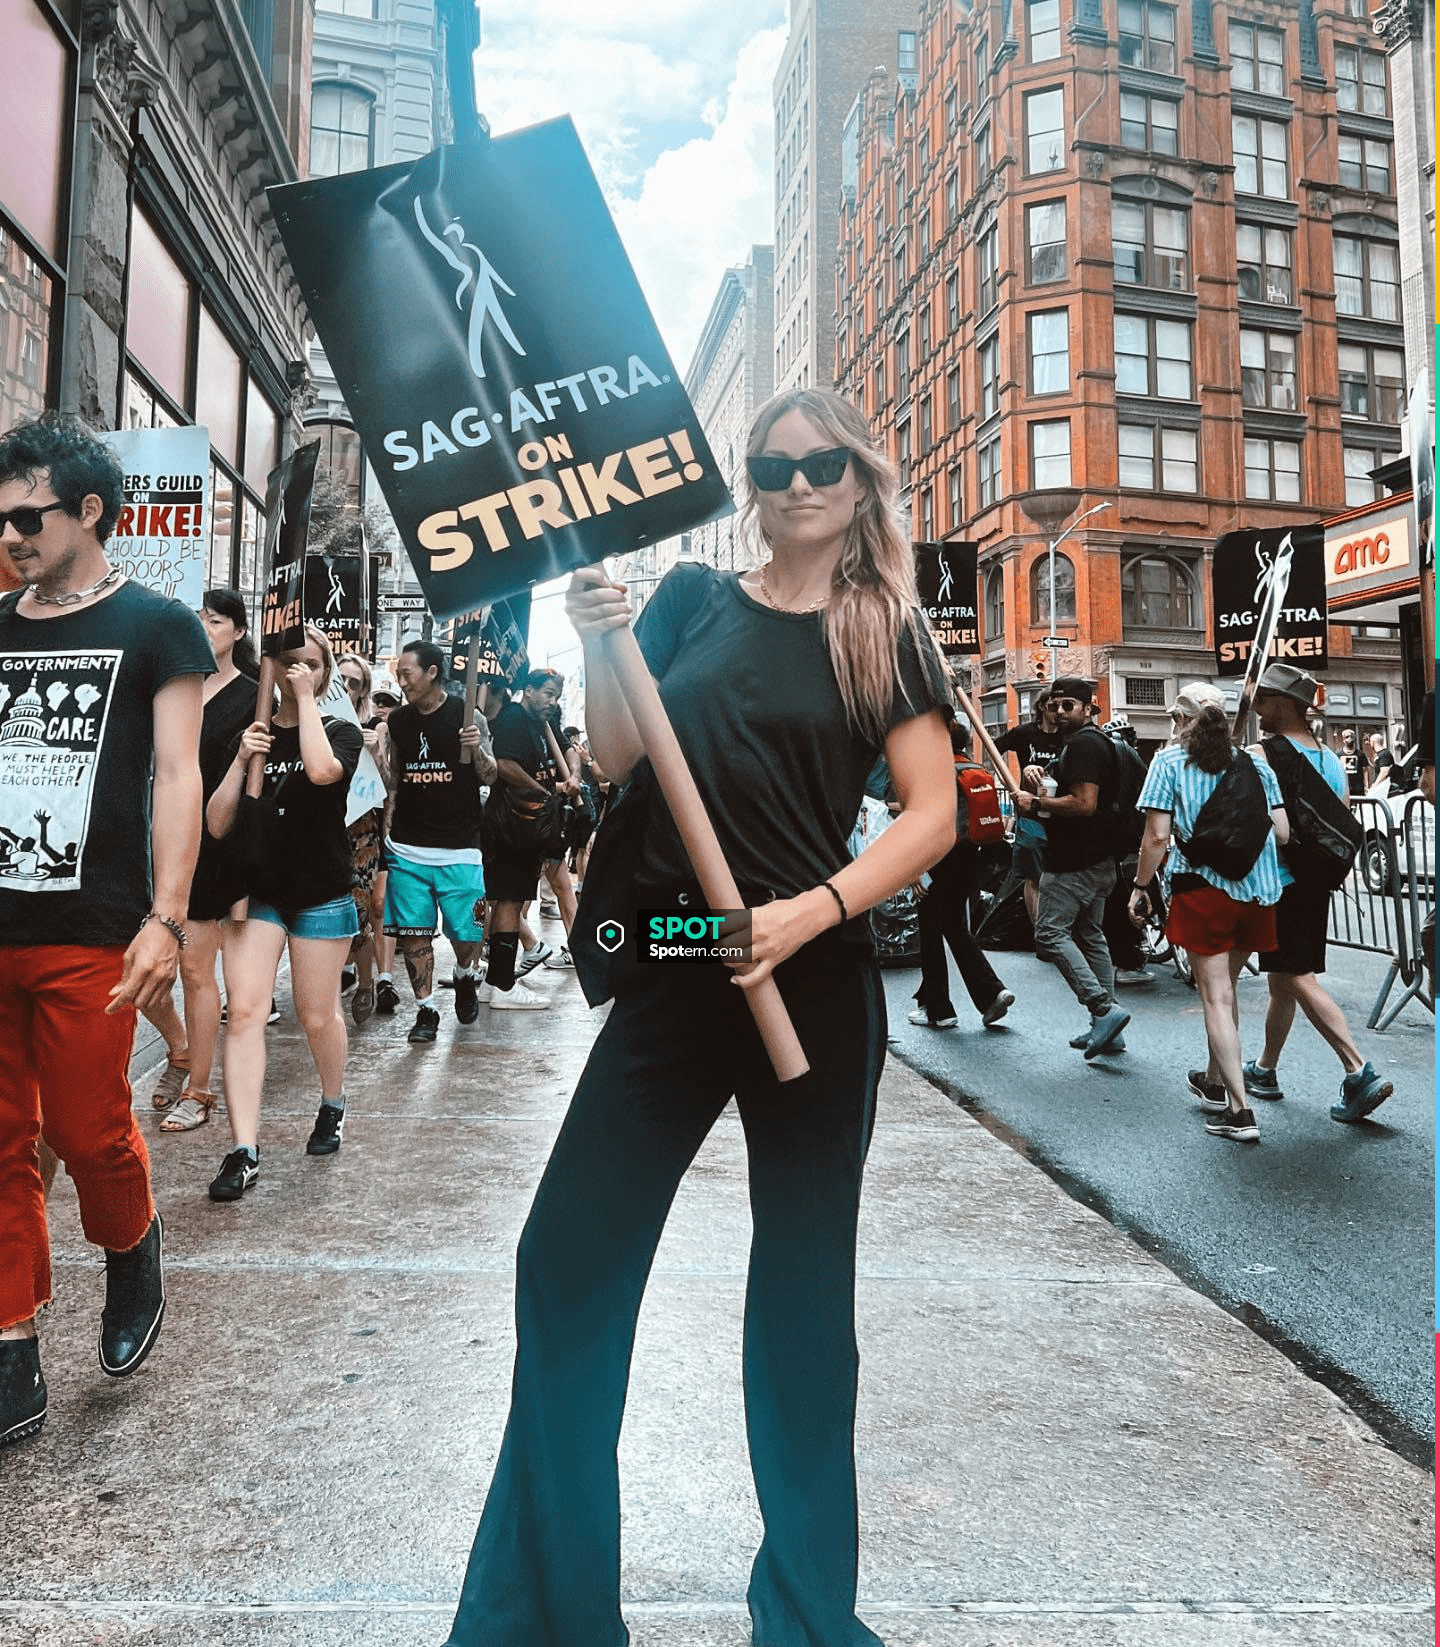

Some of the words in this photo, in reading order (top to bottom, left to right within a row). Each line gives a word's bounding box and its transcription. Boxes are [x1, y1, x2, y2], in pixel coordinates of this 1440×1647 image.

[517, 432, 574, 471] ON
[123, 474, 151, 490] ERS
[156, 474, 203, 491] GUILD
[132, 491, 150, 503] ON
[417, 428, 704, 572] STRIKE!
[116, 505, 203, 538] RIKE!
[180, 539, 205, 560] BE
[1334, 531, 1390, 576] amc
[266, 558, 302, 590] AFTRA
[377, 599, 395, 607] ONE
[402, 599, 421, 607] WAY
[262, 599, 300, 635] IKE!
[940, 620, 953, 629] ON
[327, 631, 343, 639] ON
[930, 629, 977, 645] RIKE!
[1220, 636, 1323, 662] STIKE!
[2, 656, 116, 672] GOVERNMENT
[46, 716, 98, 742] CARE.
[3, 752, 17, 761] WE
[25, 753, 47, 763] THE
[6, 765, 35, 774] MUST
[42, 766, 76, 776] HELP
[402, 771, 453, 783] TRONG
[1, 775, 29, 786] EACH
